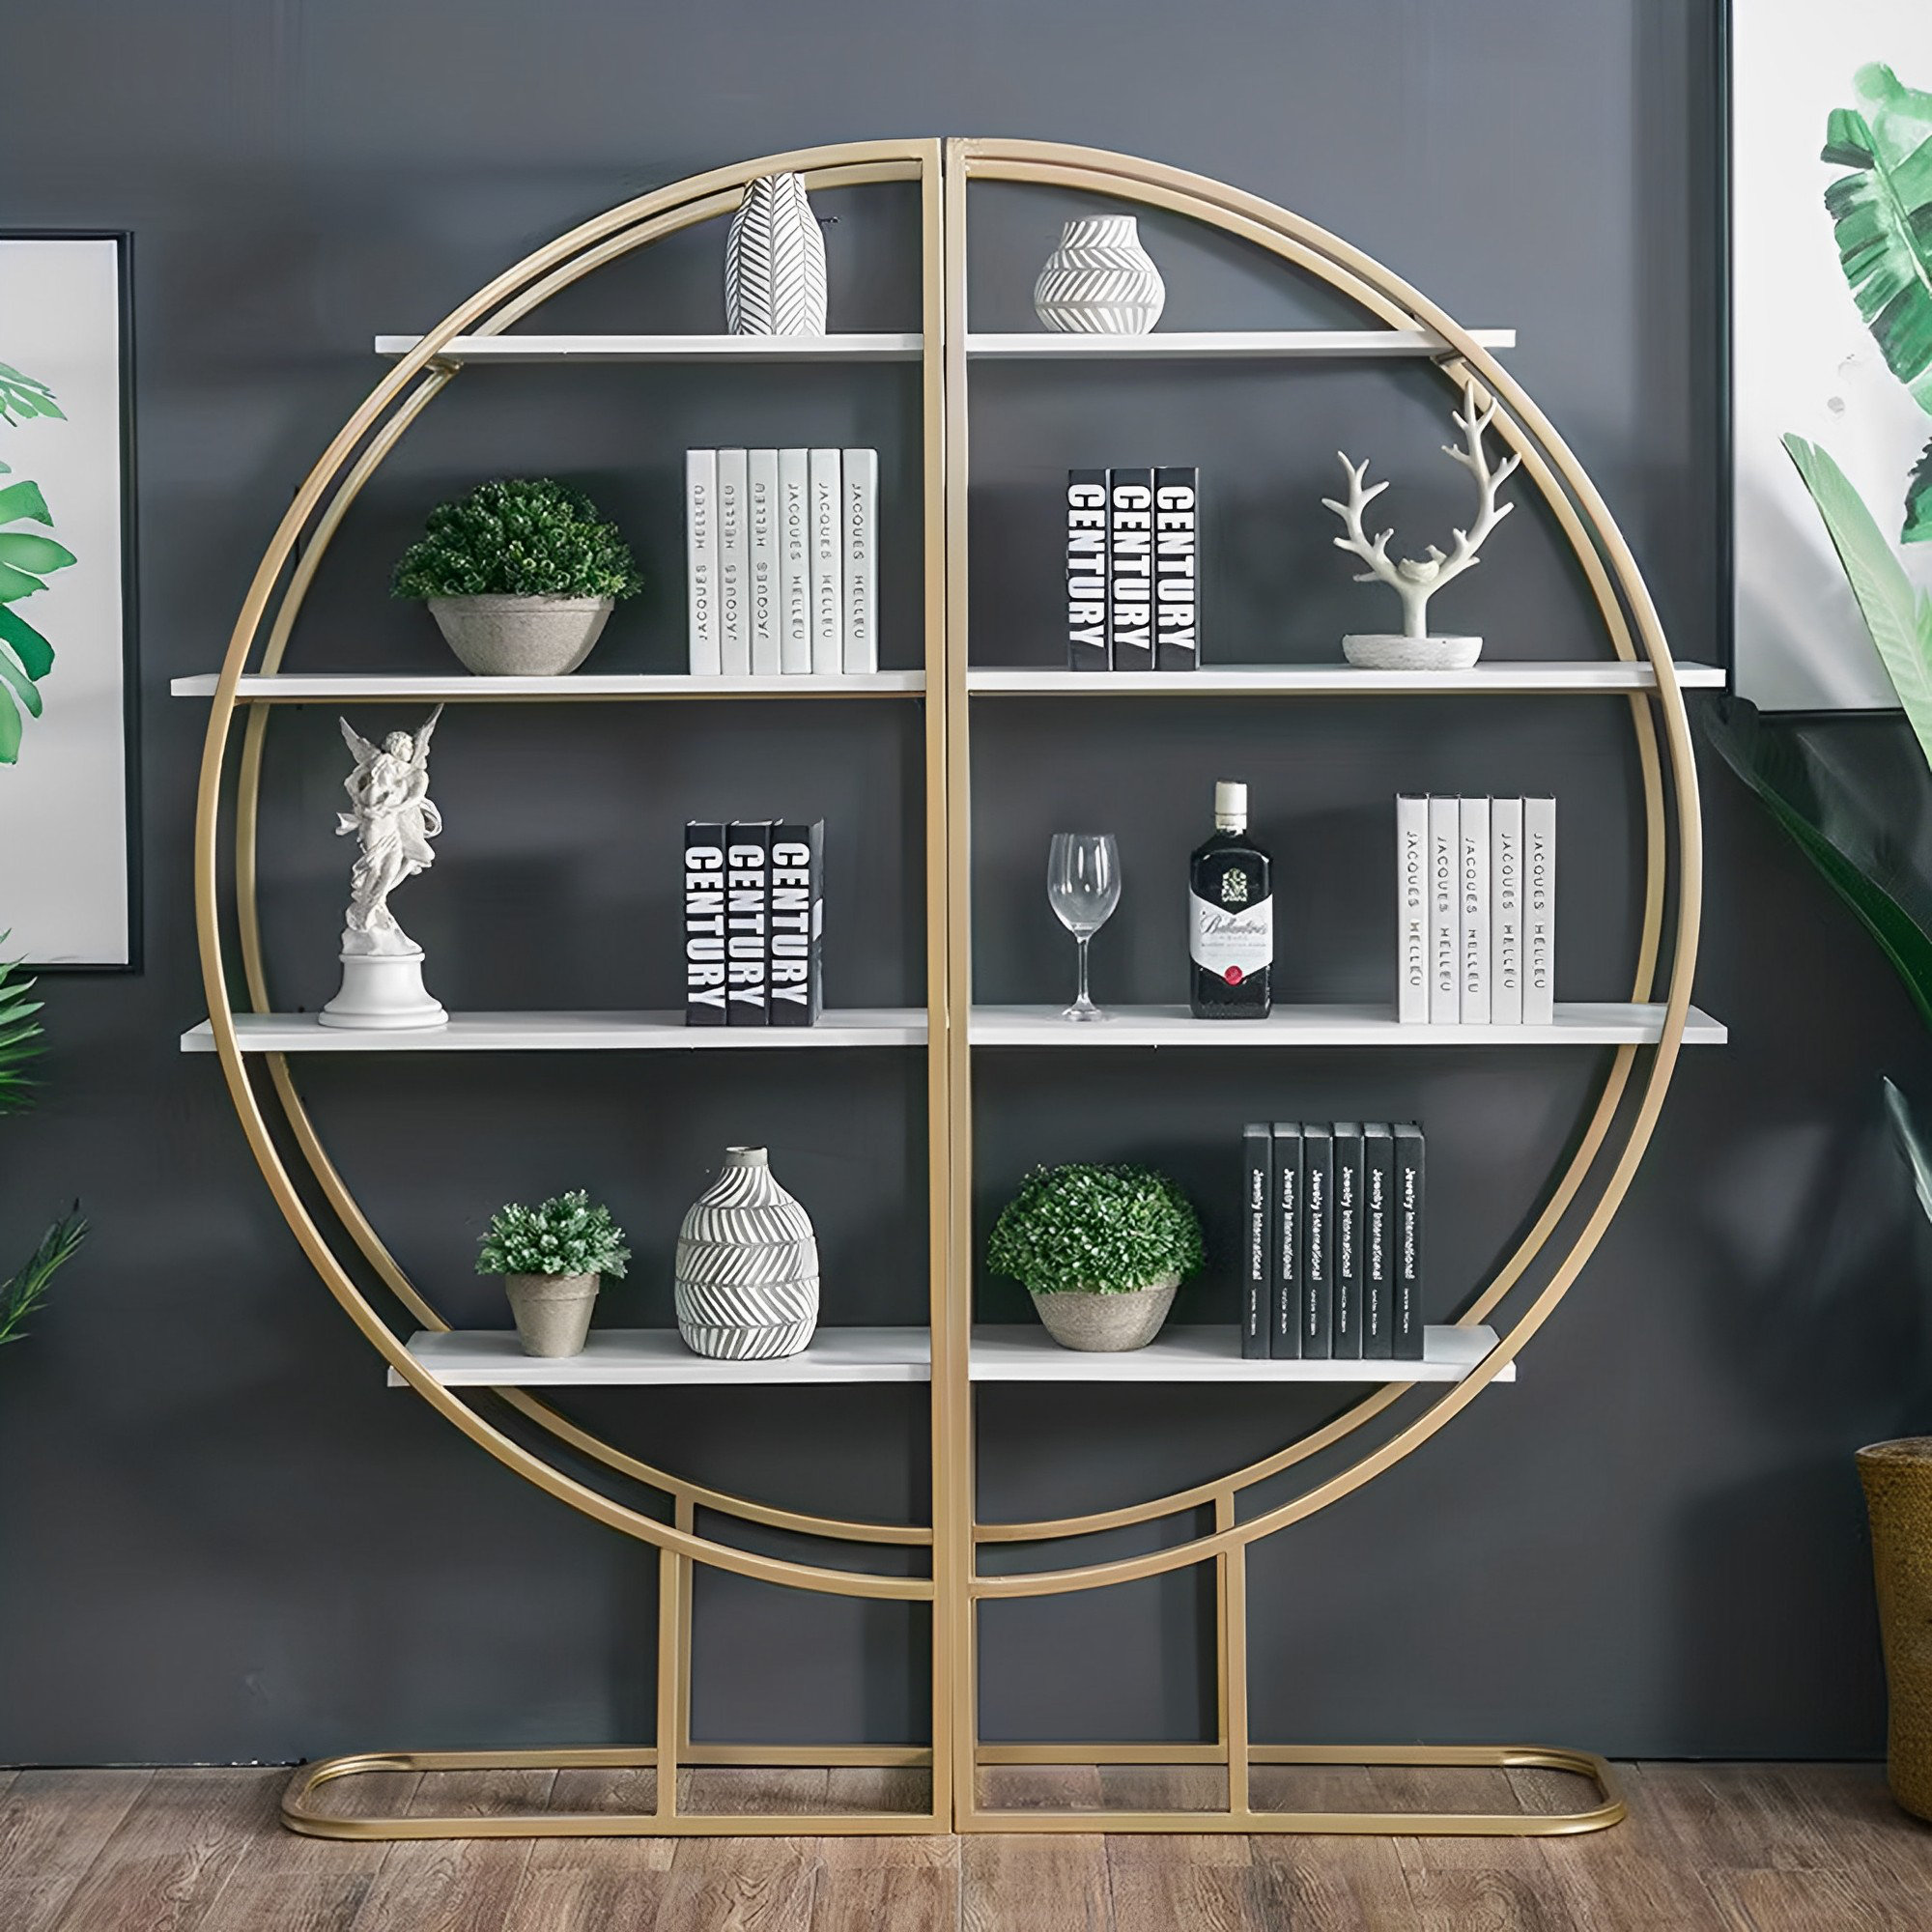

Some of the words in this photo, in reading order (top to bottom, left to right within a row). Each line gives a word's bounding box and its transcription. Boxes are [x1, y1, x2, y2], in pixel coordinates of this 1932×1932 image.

[1068, 485, 1105, 647] CENTURY
[1114, 486, 1151, 649] CENTURY
[1157, 487, 1195, 649] CENTURY
[686, 847, 725, 1008] CENTURY
[729, 845, 764, 1007] CENTURY
[772, 843, 810, 1005] CENTURY
